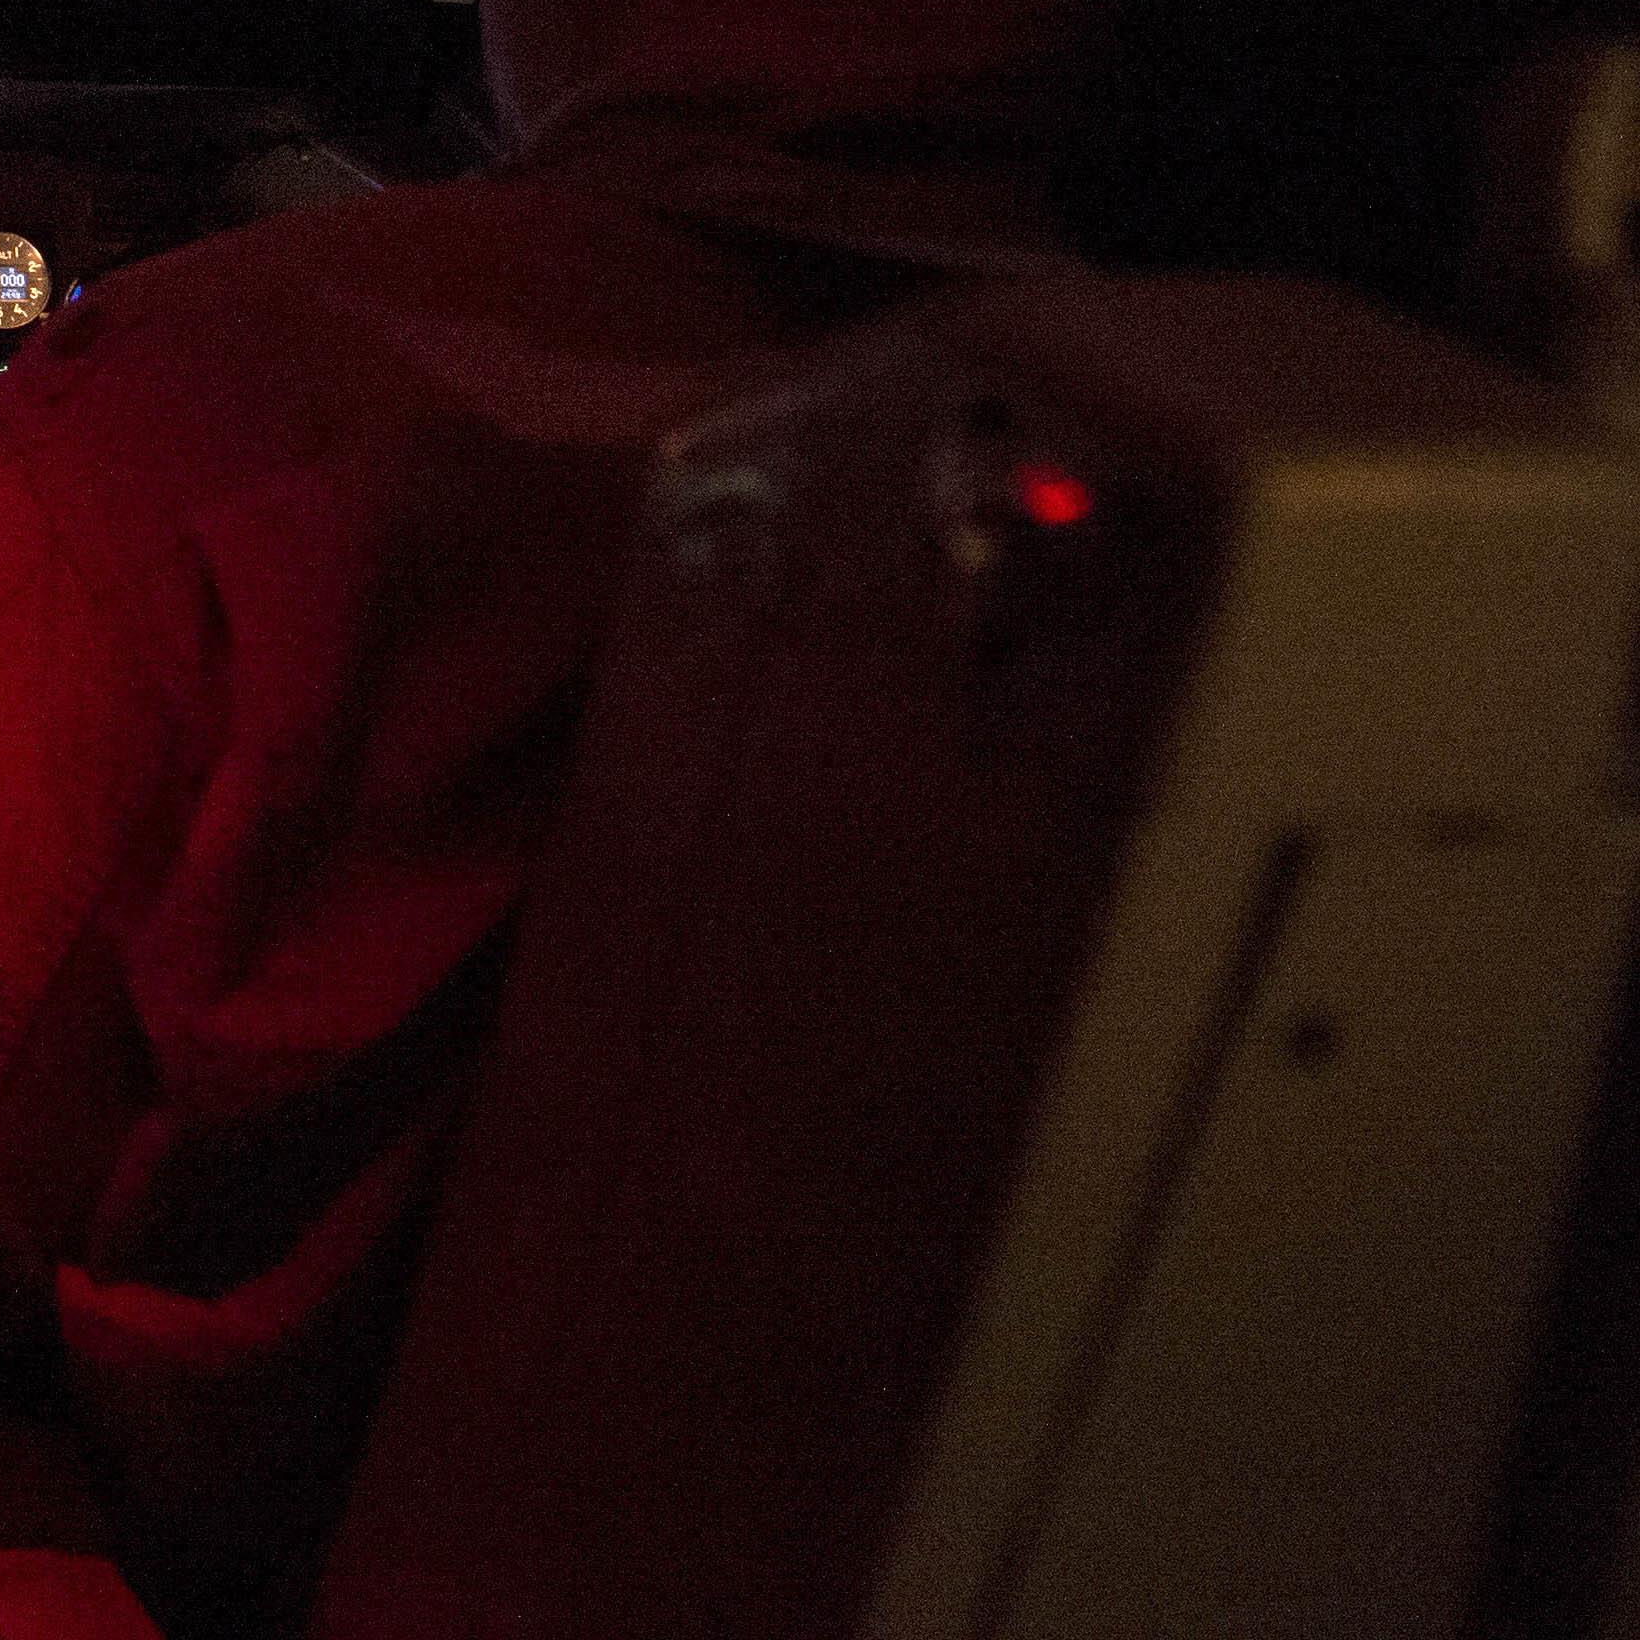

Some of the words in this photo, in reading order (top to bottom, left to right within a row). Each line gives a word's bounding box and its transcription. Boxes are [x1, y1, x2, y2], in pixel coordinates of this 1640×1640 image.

[15, 247, 18, 258] 1
[28, 261, 36, 272] 2
[30, 288, 38, 299] 3
[14, 304, 22, 314] 4
